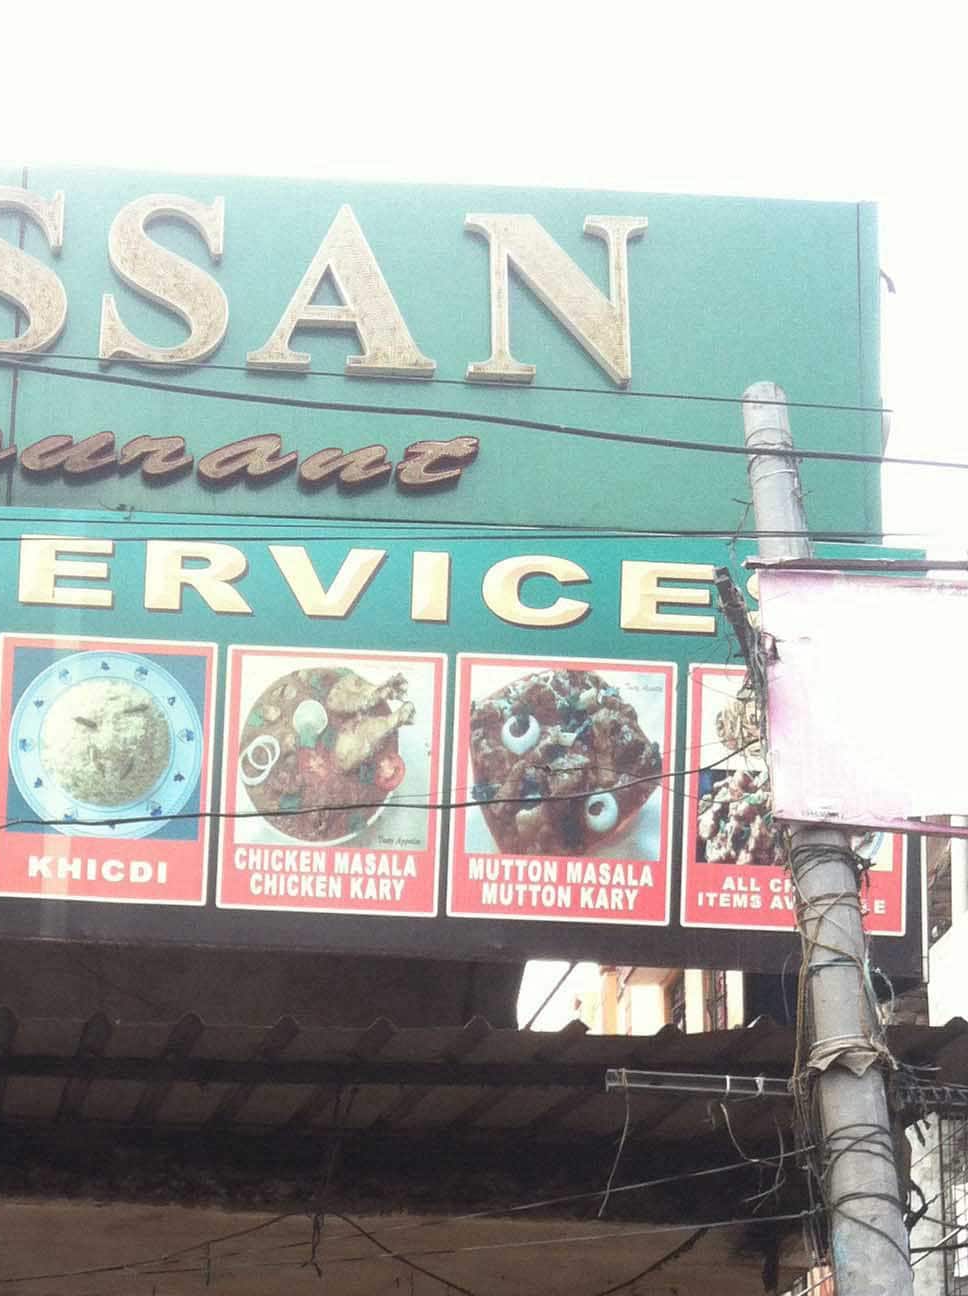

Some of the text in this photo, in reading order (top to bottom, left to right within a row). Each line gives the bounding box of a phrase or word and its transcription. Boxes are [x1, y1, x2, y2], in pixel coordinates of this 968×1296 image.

[27, 855, 169, 885] KHICDI
[233, 847, 417, 879] CHICKEN MASALA
[468, 857, 654, 888] MUTTON MASALA
[249, 874, 406, 902] CHICKEN KARY
[481, 881, 639, 911] MUTTON KARY
[722, 875, 761, 893] ALL
[697, 891, 762, 910] ITEMS
